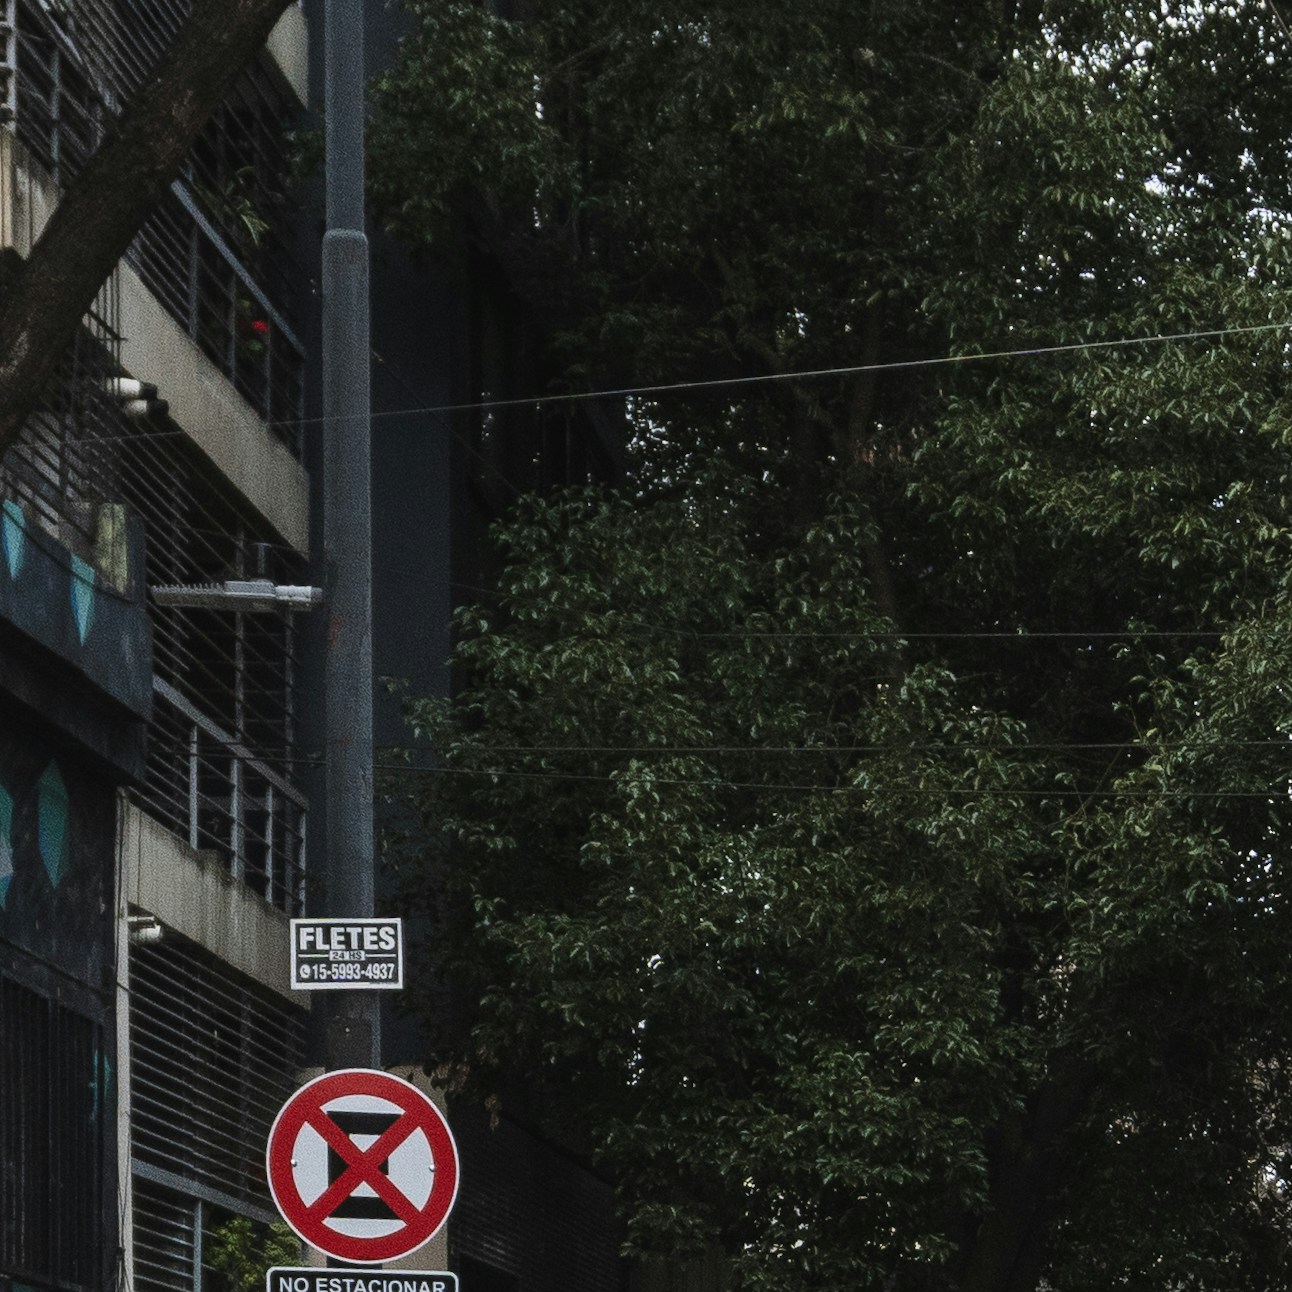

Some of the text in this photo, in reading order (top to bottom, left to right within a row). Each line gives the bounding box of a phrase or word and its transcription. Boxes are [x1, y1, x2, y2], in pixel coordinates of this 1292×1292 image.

[299, 926, 396, 950] FLETES
[332, 951, 362, 960] 24 HS
[312, 963, 395, 980] 15-5993-4937
